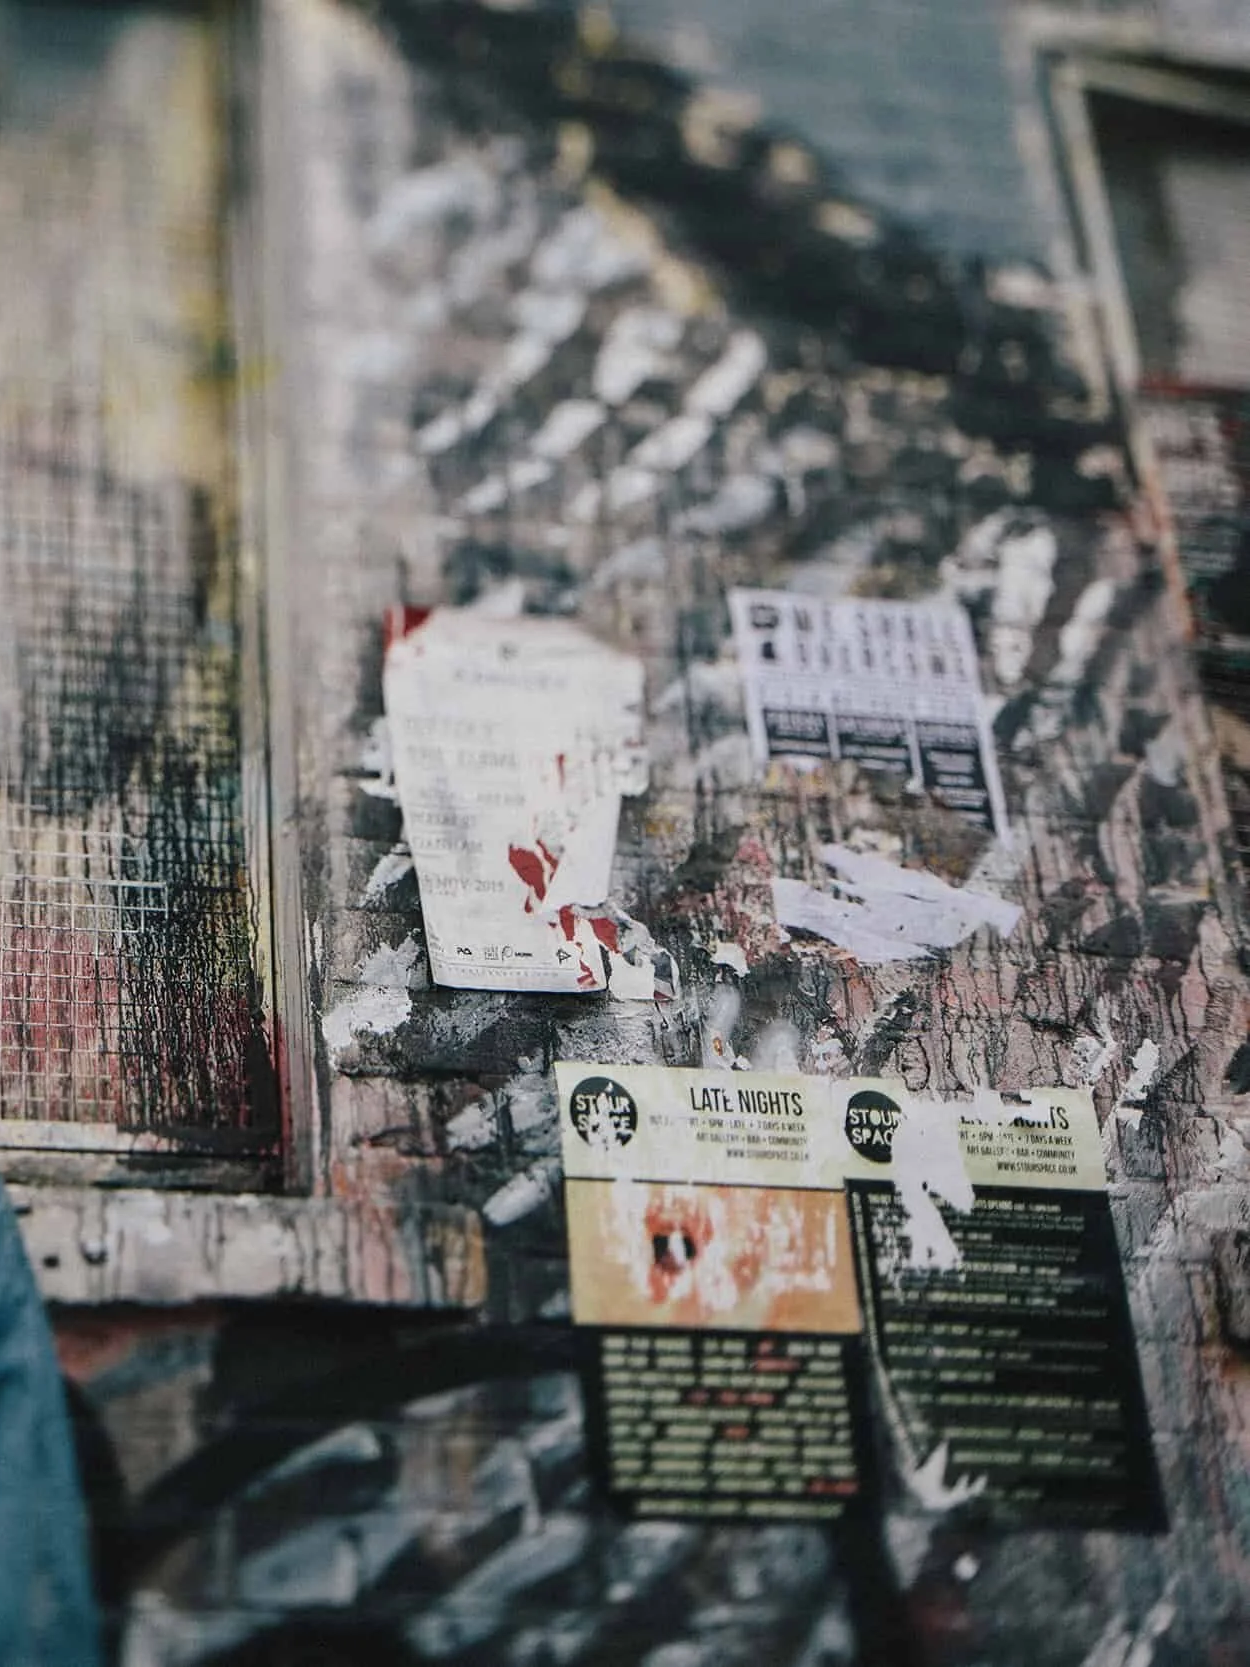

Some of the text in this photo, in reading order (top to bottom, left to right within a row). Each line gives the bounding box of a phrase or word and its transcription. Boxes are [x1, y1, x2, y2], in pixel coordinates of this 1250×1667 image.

[689, 1086, 803, 1117] LATE NIGHTS
[576, 1113, 631, 1132] SCE
[851, 1127, 895, 1146] SPAC
[1030, 1134, 1048, 1145] DAYS
[1054, 1136, 1074, 1147] WEEK
[1035, 1148, 1076, 1160] COMMUNITY
